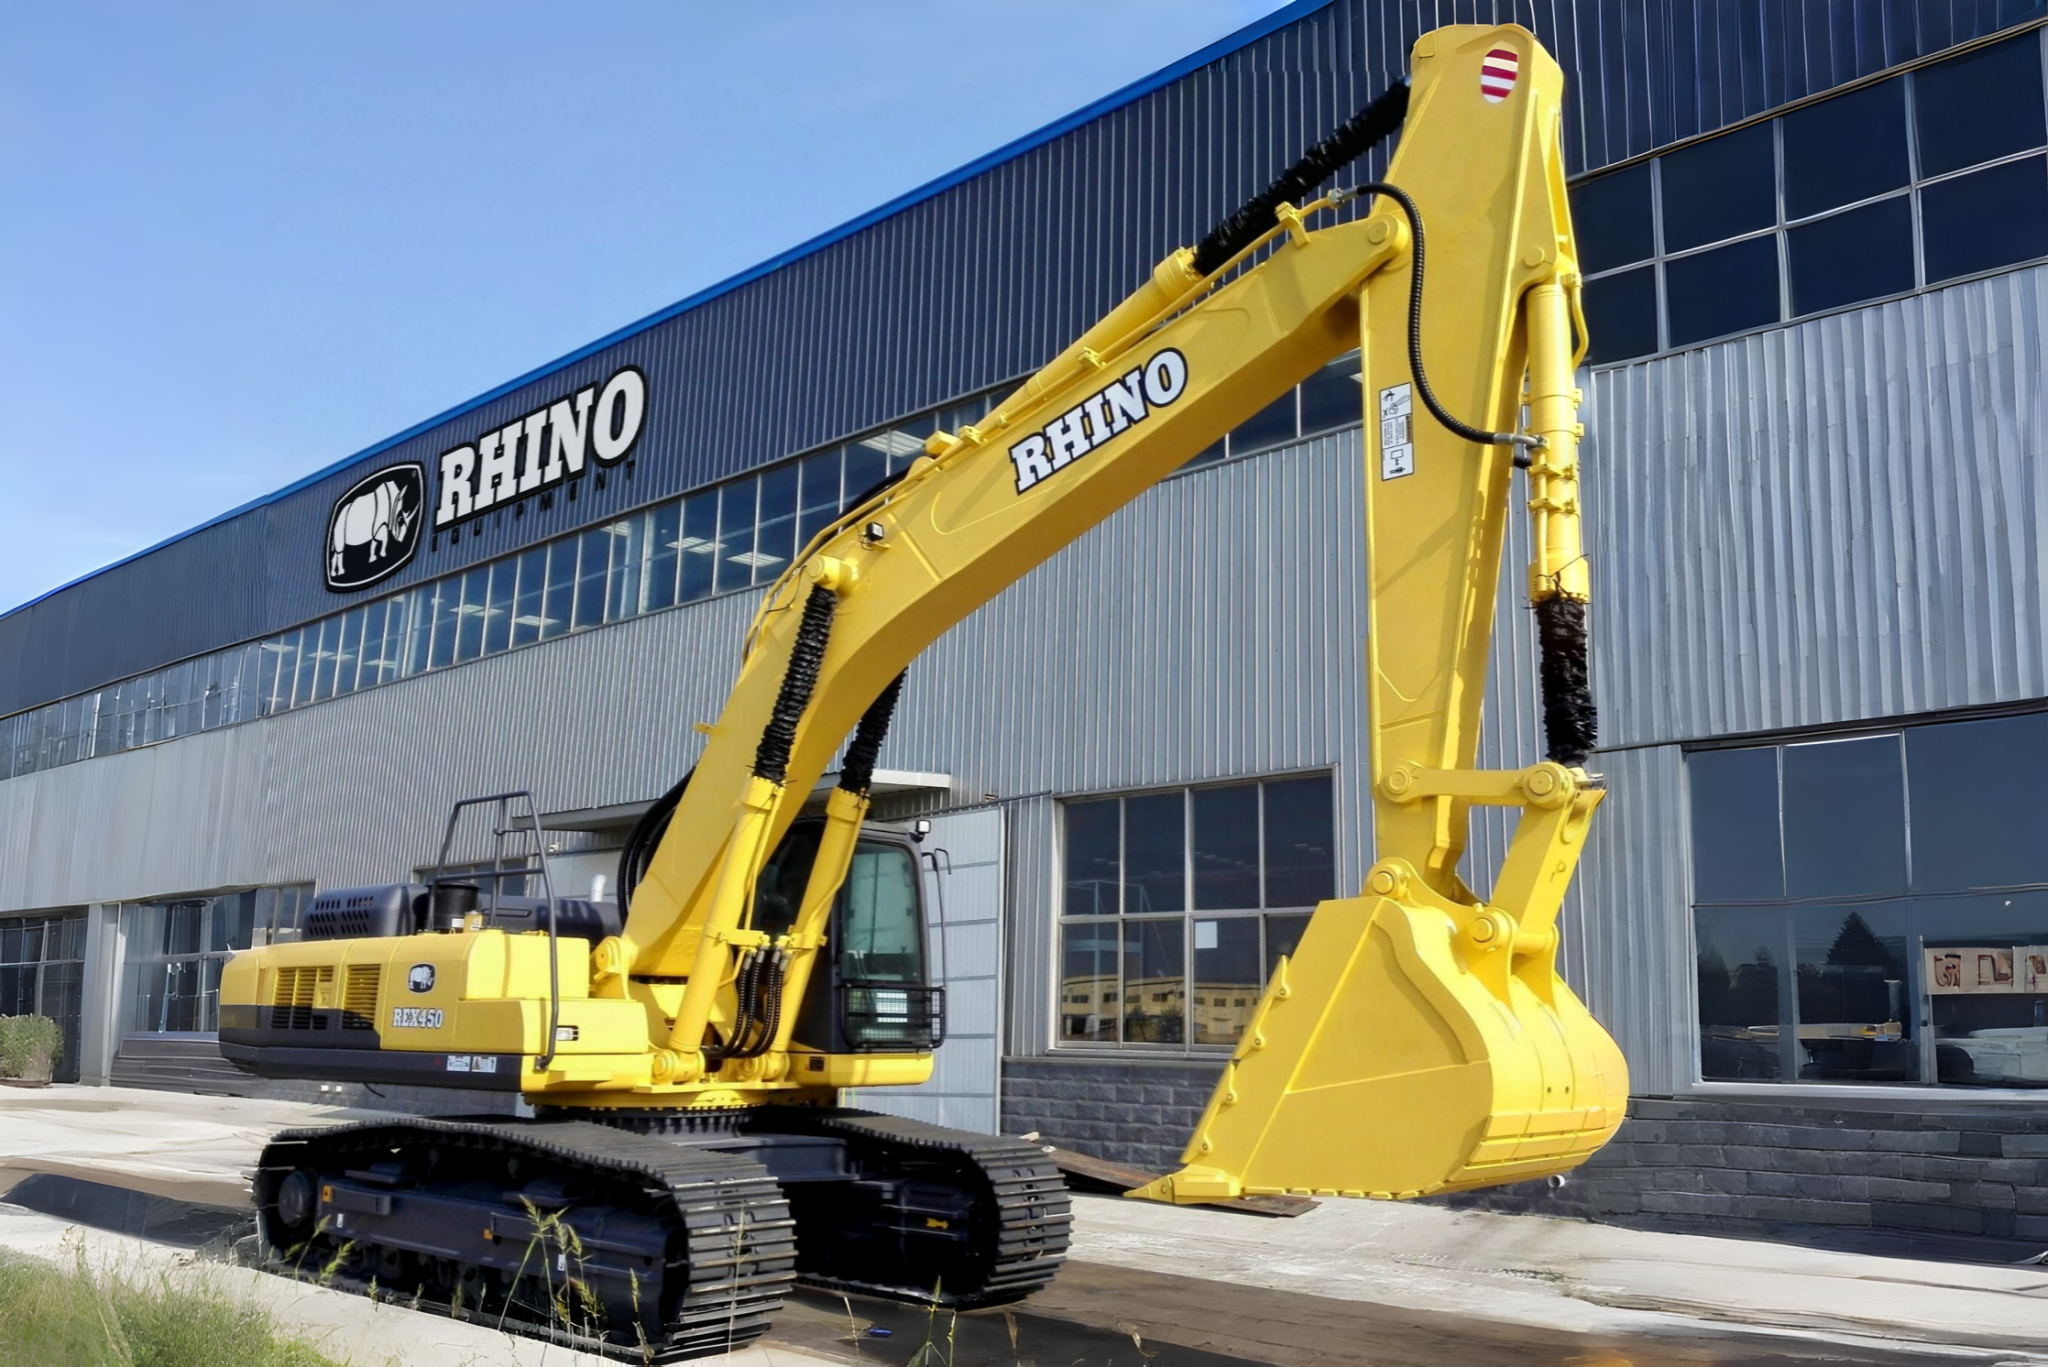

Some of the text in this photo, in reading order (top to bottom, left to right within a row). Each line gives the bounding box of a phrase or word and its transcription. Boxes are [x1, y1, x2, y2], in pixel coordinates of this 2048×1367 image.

[434, 366, 647, 529] RHINO
[1009, 348, 1187, 494] RHINO
[431, 460, 635, 552] EQUIPMENT
[392, 1007, 443, 1029] REX450
